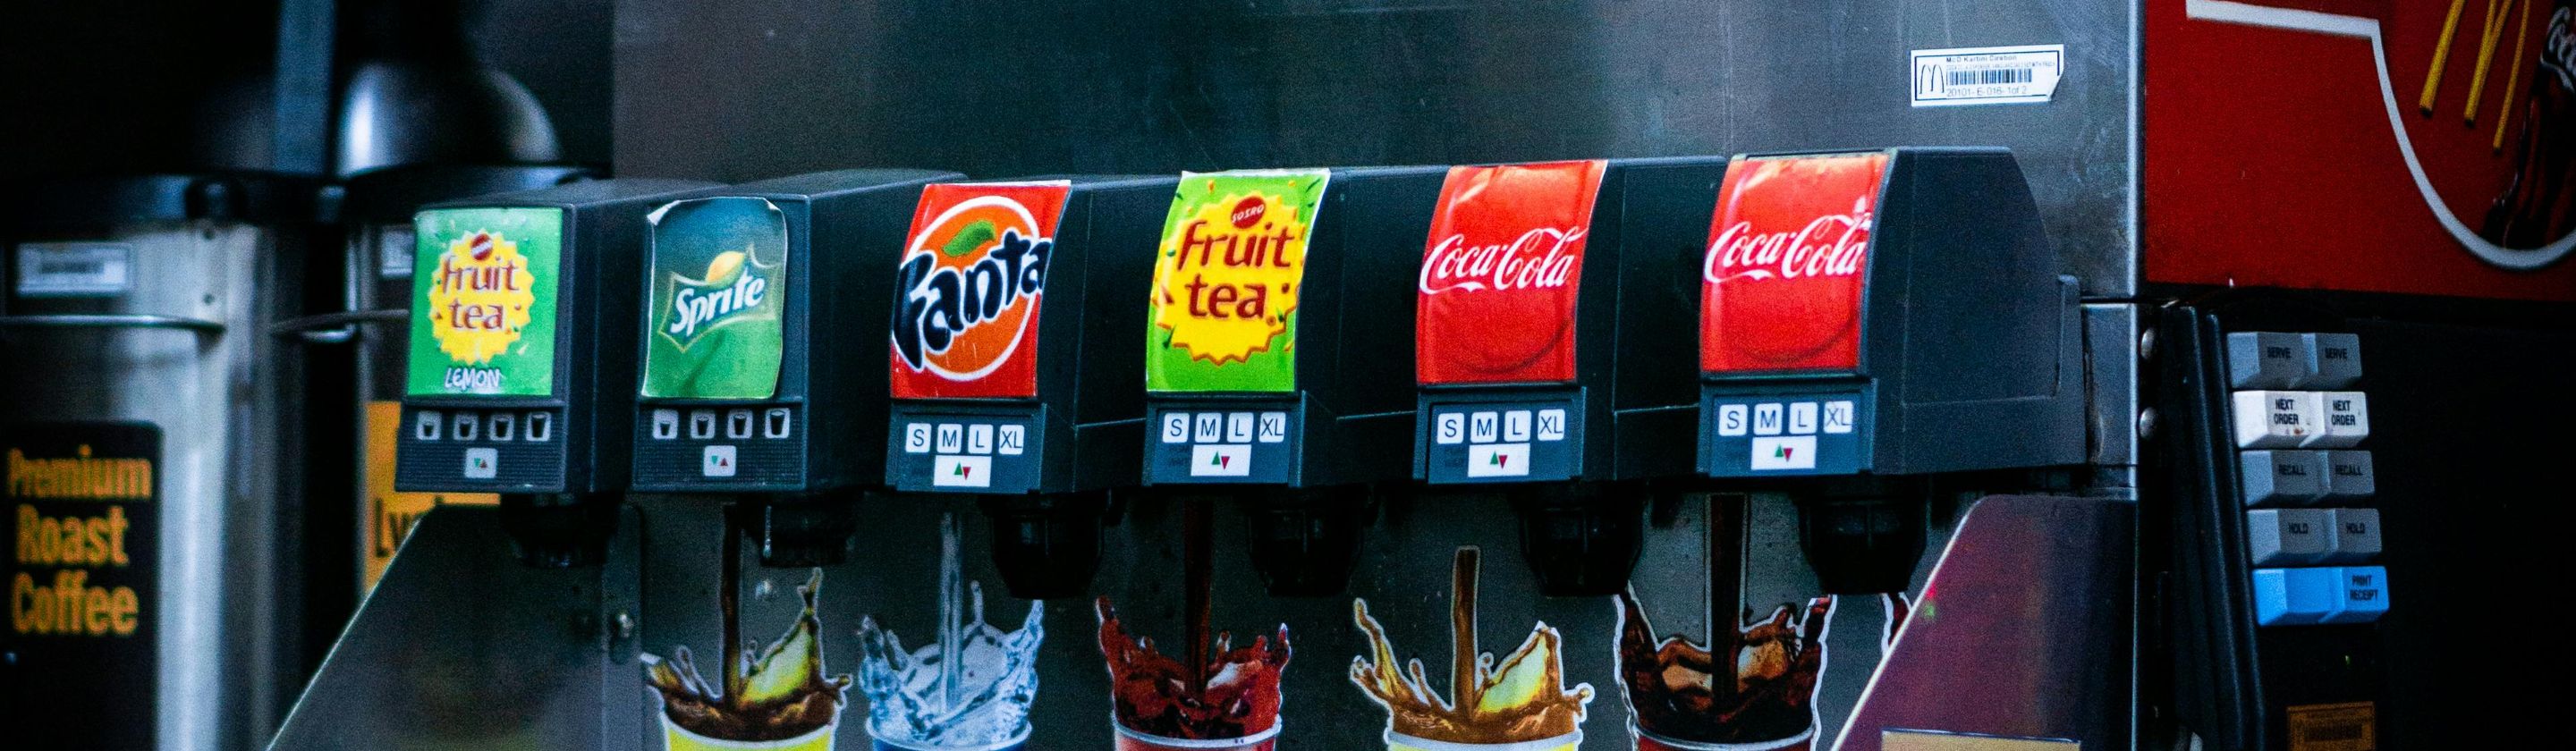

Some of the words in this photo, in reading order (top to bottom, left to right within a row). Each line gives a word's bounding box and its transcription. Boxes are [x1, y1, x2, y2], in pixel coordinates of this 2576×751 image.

[1232, 204, 1265, 224] SOSRO
[1177, 220, 1295, 272] fruit
[1705, 215, 1871, 283] Coca-Cola
[1419, 226, 1589, 295] Coca-Cola
[443, 254, 521, 294] fruit
[670, 269, 766, 337] Sprite
[893, 228, 1053, 369] Fanta
[1185, 274, 1267, 320] tea
[448, 299, 504, 330] tea
[2267, 347, 2292, 359] SERVE
[2326, 348, 2348, 359] SERVE
[445, 367, 502, 392] LEMON
[2275, 399, 2294, 410] NEXT
[2333, 400, 2351, 411] NEXT
[1170, 418, 1182, 437] S
[1200, 418, 1216, 436] M
[1234, 418, 1244, 436] L
[1260, 417, 1284, 436] XL
[1444, 419, 1457, 438] S
[1476, 419, 1492, 437] M
[1512, 418, 1522, 436] L
[1539, 417, 1563, 435] XL
[1726, 410, 1741, 429] S
[1759, 409, 1776, 428] M
[1798, 409, 1808, 427] L
[1825, 408, 1852, 427] XL
[2274, 413, 2299, 425] ORDER
[2331, 414, 2355, 426] ORDER
[911, 429, 925, 448] S
[942, 429, 957, 447] M
[974, 430, 985, 448] L
[1000, 430, 1023, 449] XL
[8, 444, 152, 498] Premium
[2278, 464, 2307, 477] RECALL
[2335, 464, 2363, 477] RECALL
[17, 504, 129, 564] Roast
[2288, 522, 2309, 534] HOLD
[2345, 522, 2366, 534] HOLD
[2351, 575, 2373, 586] PRINT
[13, 570, 139, 634] Coffee
[2349, 589, 2378, 602] RECEIPT
